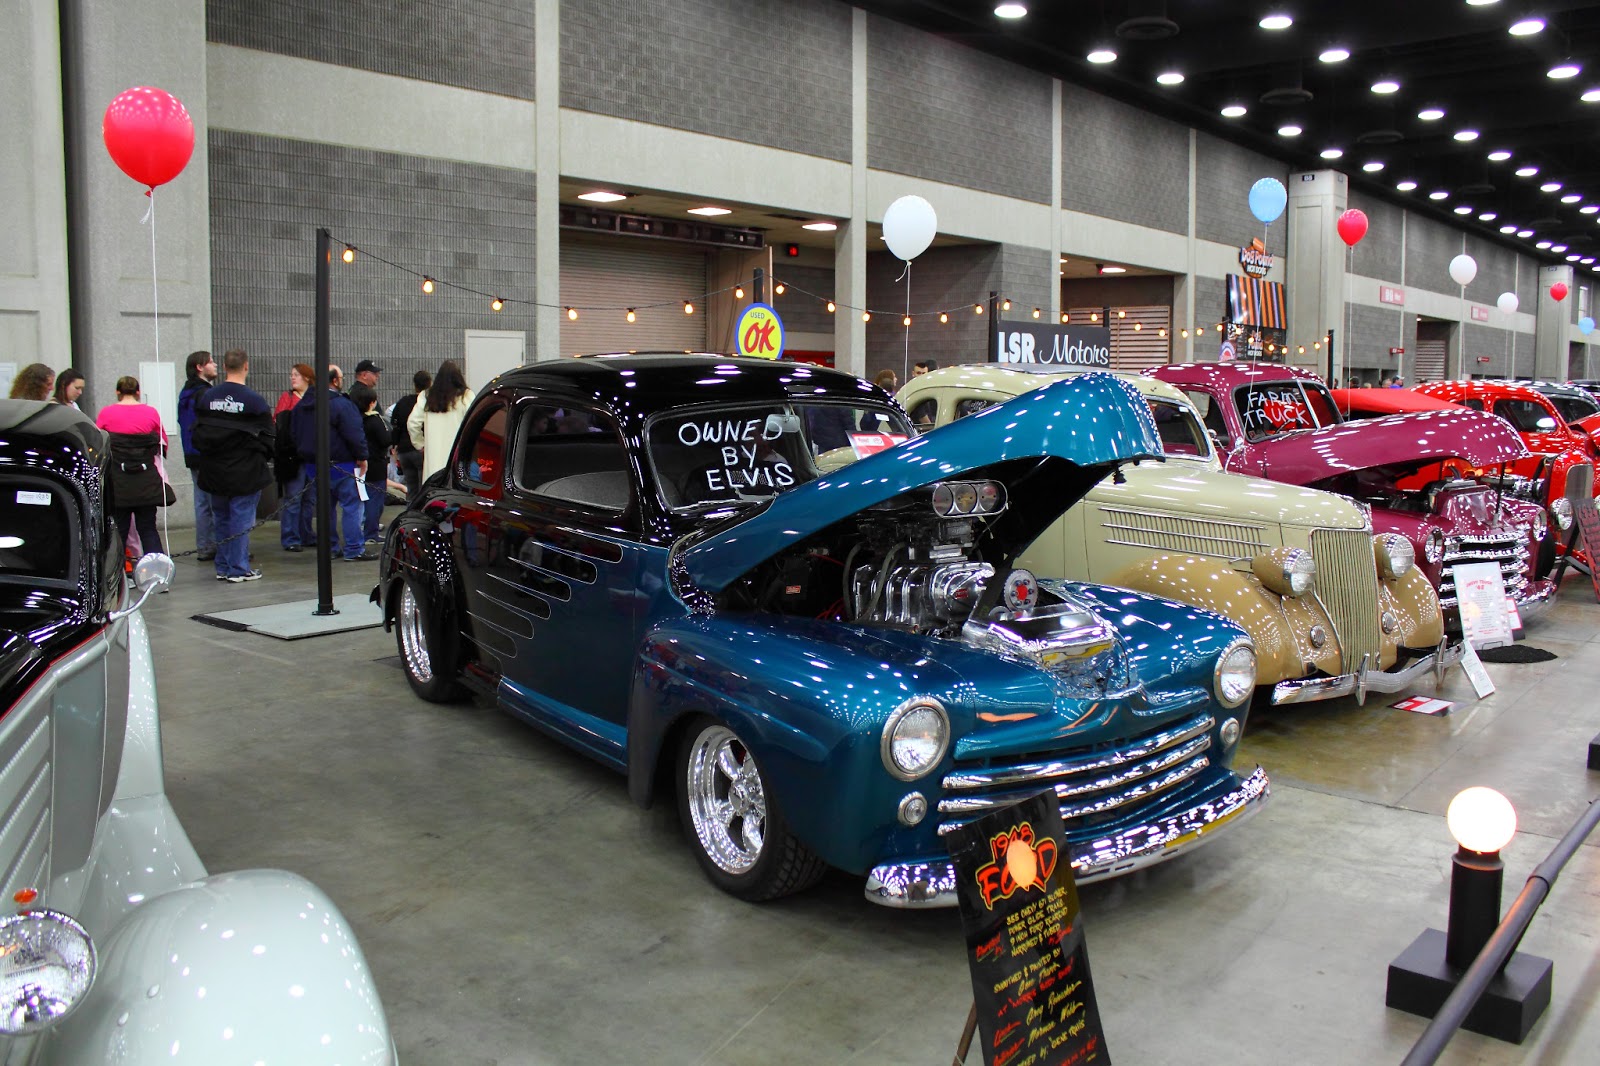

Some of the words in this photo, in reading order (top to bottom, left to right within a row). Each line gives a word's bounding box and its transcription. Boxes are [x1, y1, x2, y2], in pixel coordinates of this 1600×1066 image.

[744, 319, 775, 353] OK
[998, 331, 1036, 364] LSR
[1039, 334, 1109, 365] Motors
[1247, 391, 1302, 408] FARM
[1243, 408, 1309, 428] TRUCK
[678, 419, 783, 446] OWNED
[721, 443, 757, 468] BY
[706, 462, 795, 491] ELVIS
[976, 841, 1057, 907] FOD
